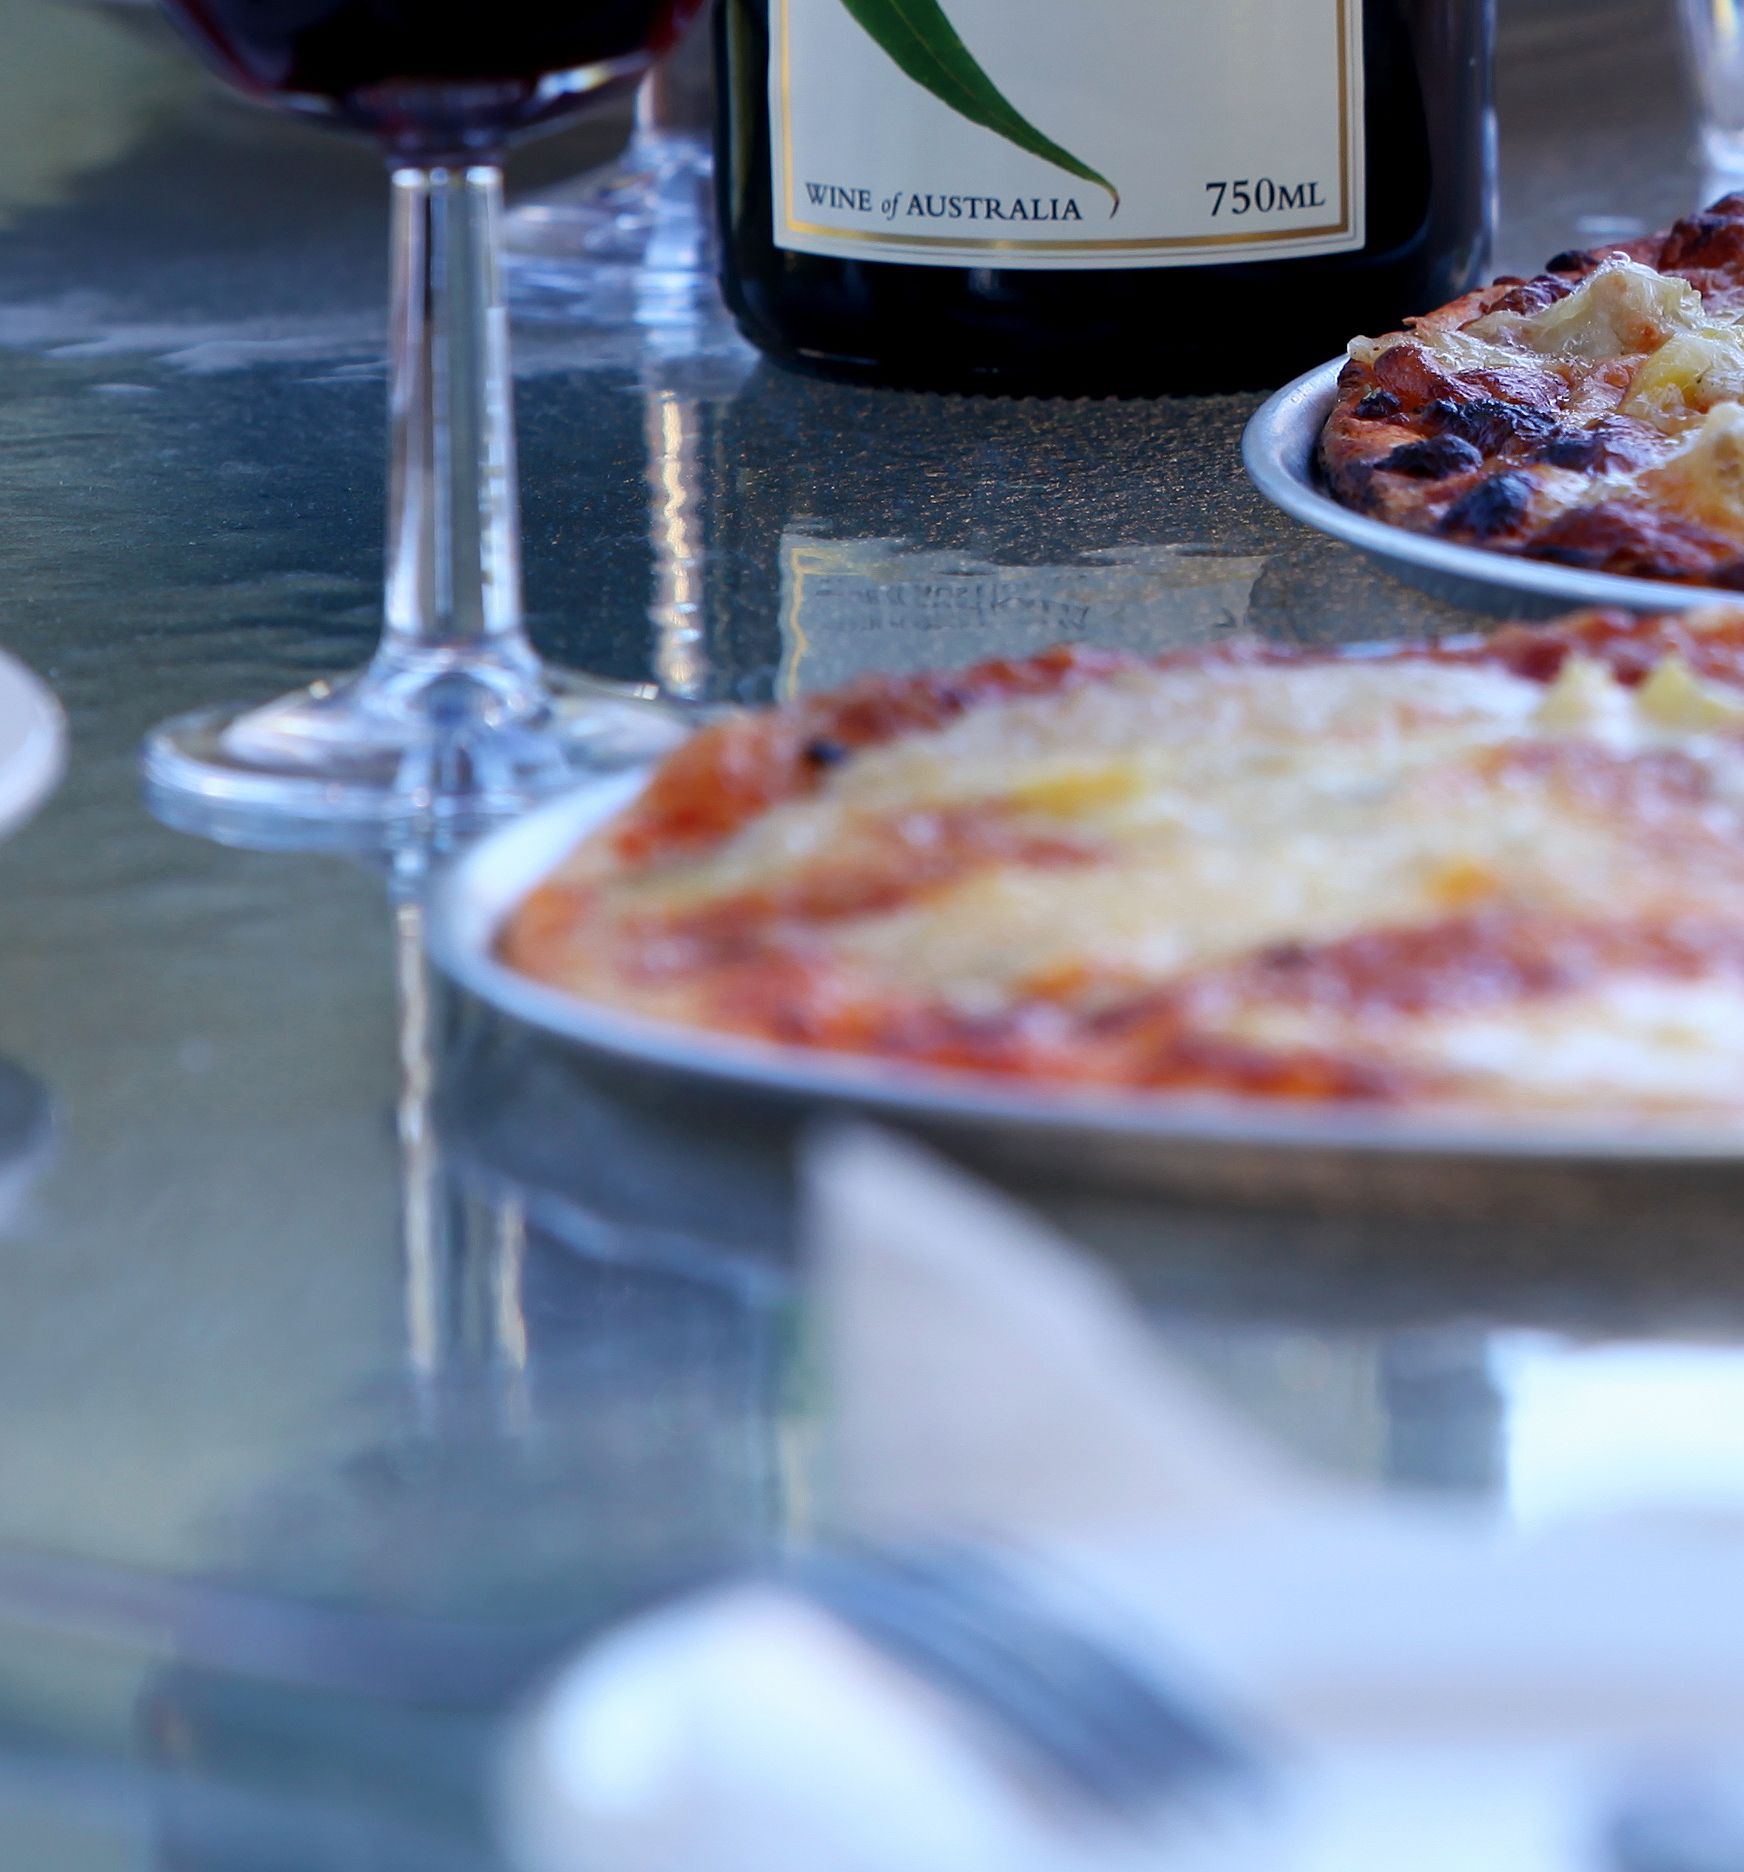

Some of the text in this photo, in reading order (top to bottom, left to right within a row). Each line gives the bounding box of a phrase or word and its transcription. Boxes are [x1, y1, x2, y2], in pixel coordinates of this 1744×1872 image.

[806, 182, 1083, 222] WINE of AUSTRALIA
[1205, 177, 1326, 218] 750ML
